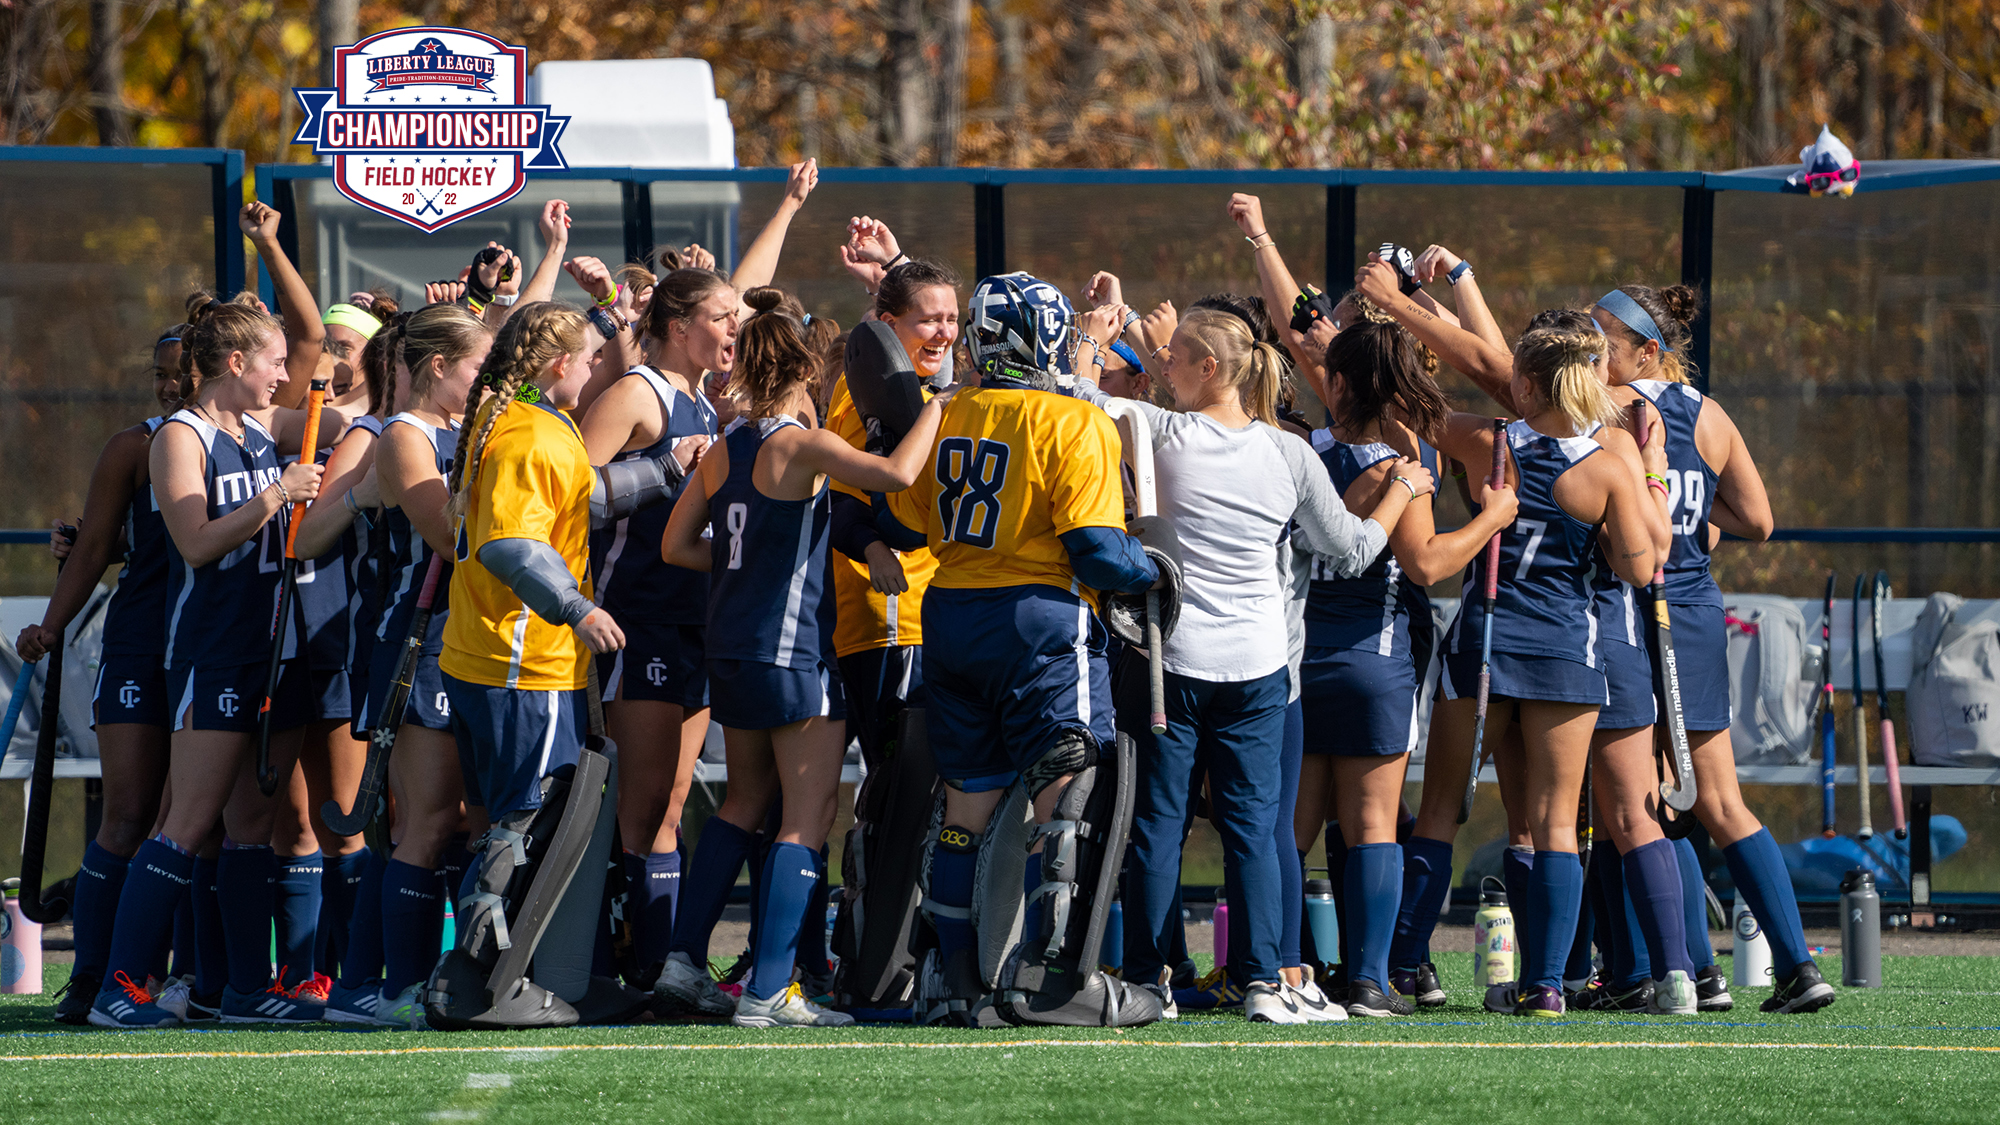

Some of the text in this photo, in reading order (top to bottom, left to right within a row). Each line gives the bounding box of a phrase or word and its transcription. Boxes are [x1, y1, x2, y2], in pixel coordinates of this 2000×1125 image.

[1003, 367, 1024, 379] ROBO
[215, 466, 282, 506] ITHAC
[1664, 468, 1706, 536] 29
[726, 502, 748, 570] 8
[1515, 517, 1547, 579] 7
[1961, 702, 1988, 724] KW
[1676, 714, 1688, 751] indian
[1682, 752, 1693, 772] the
